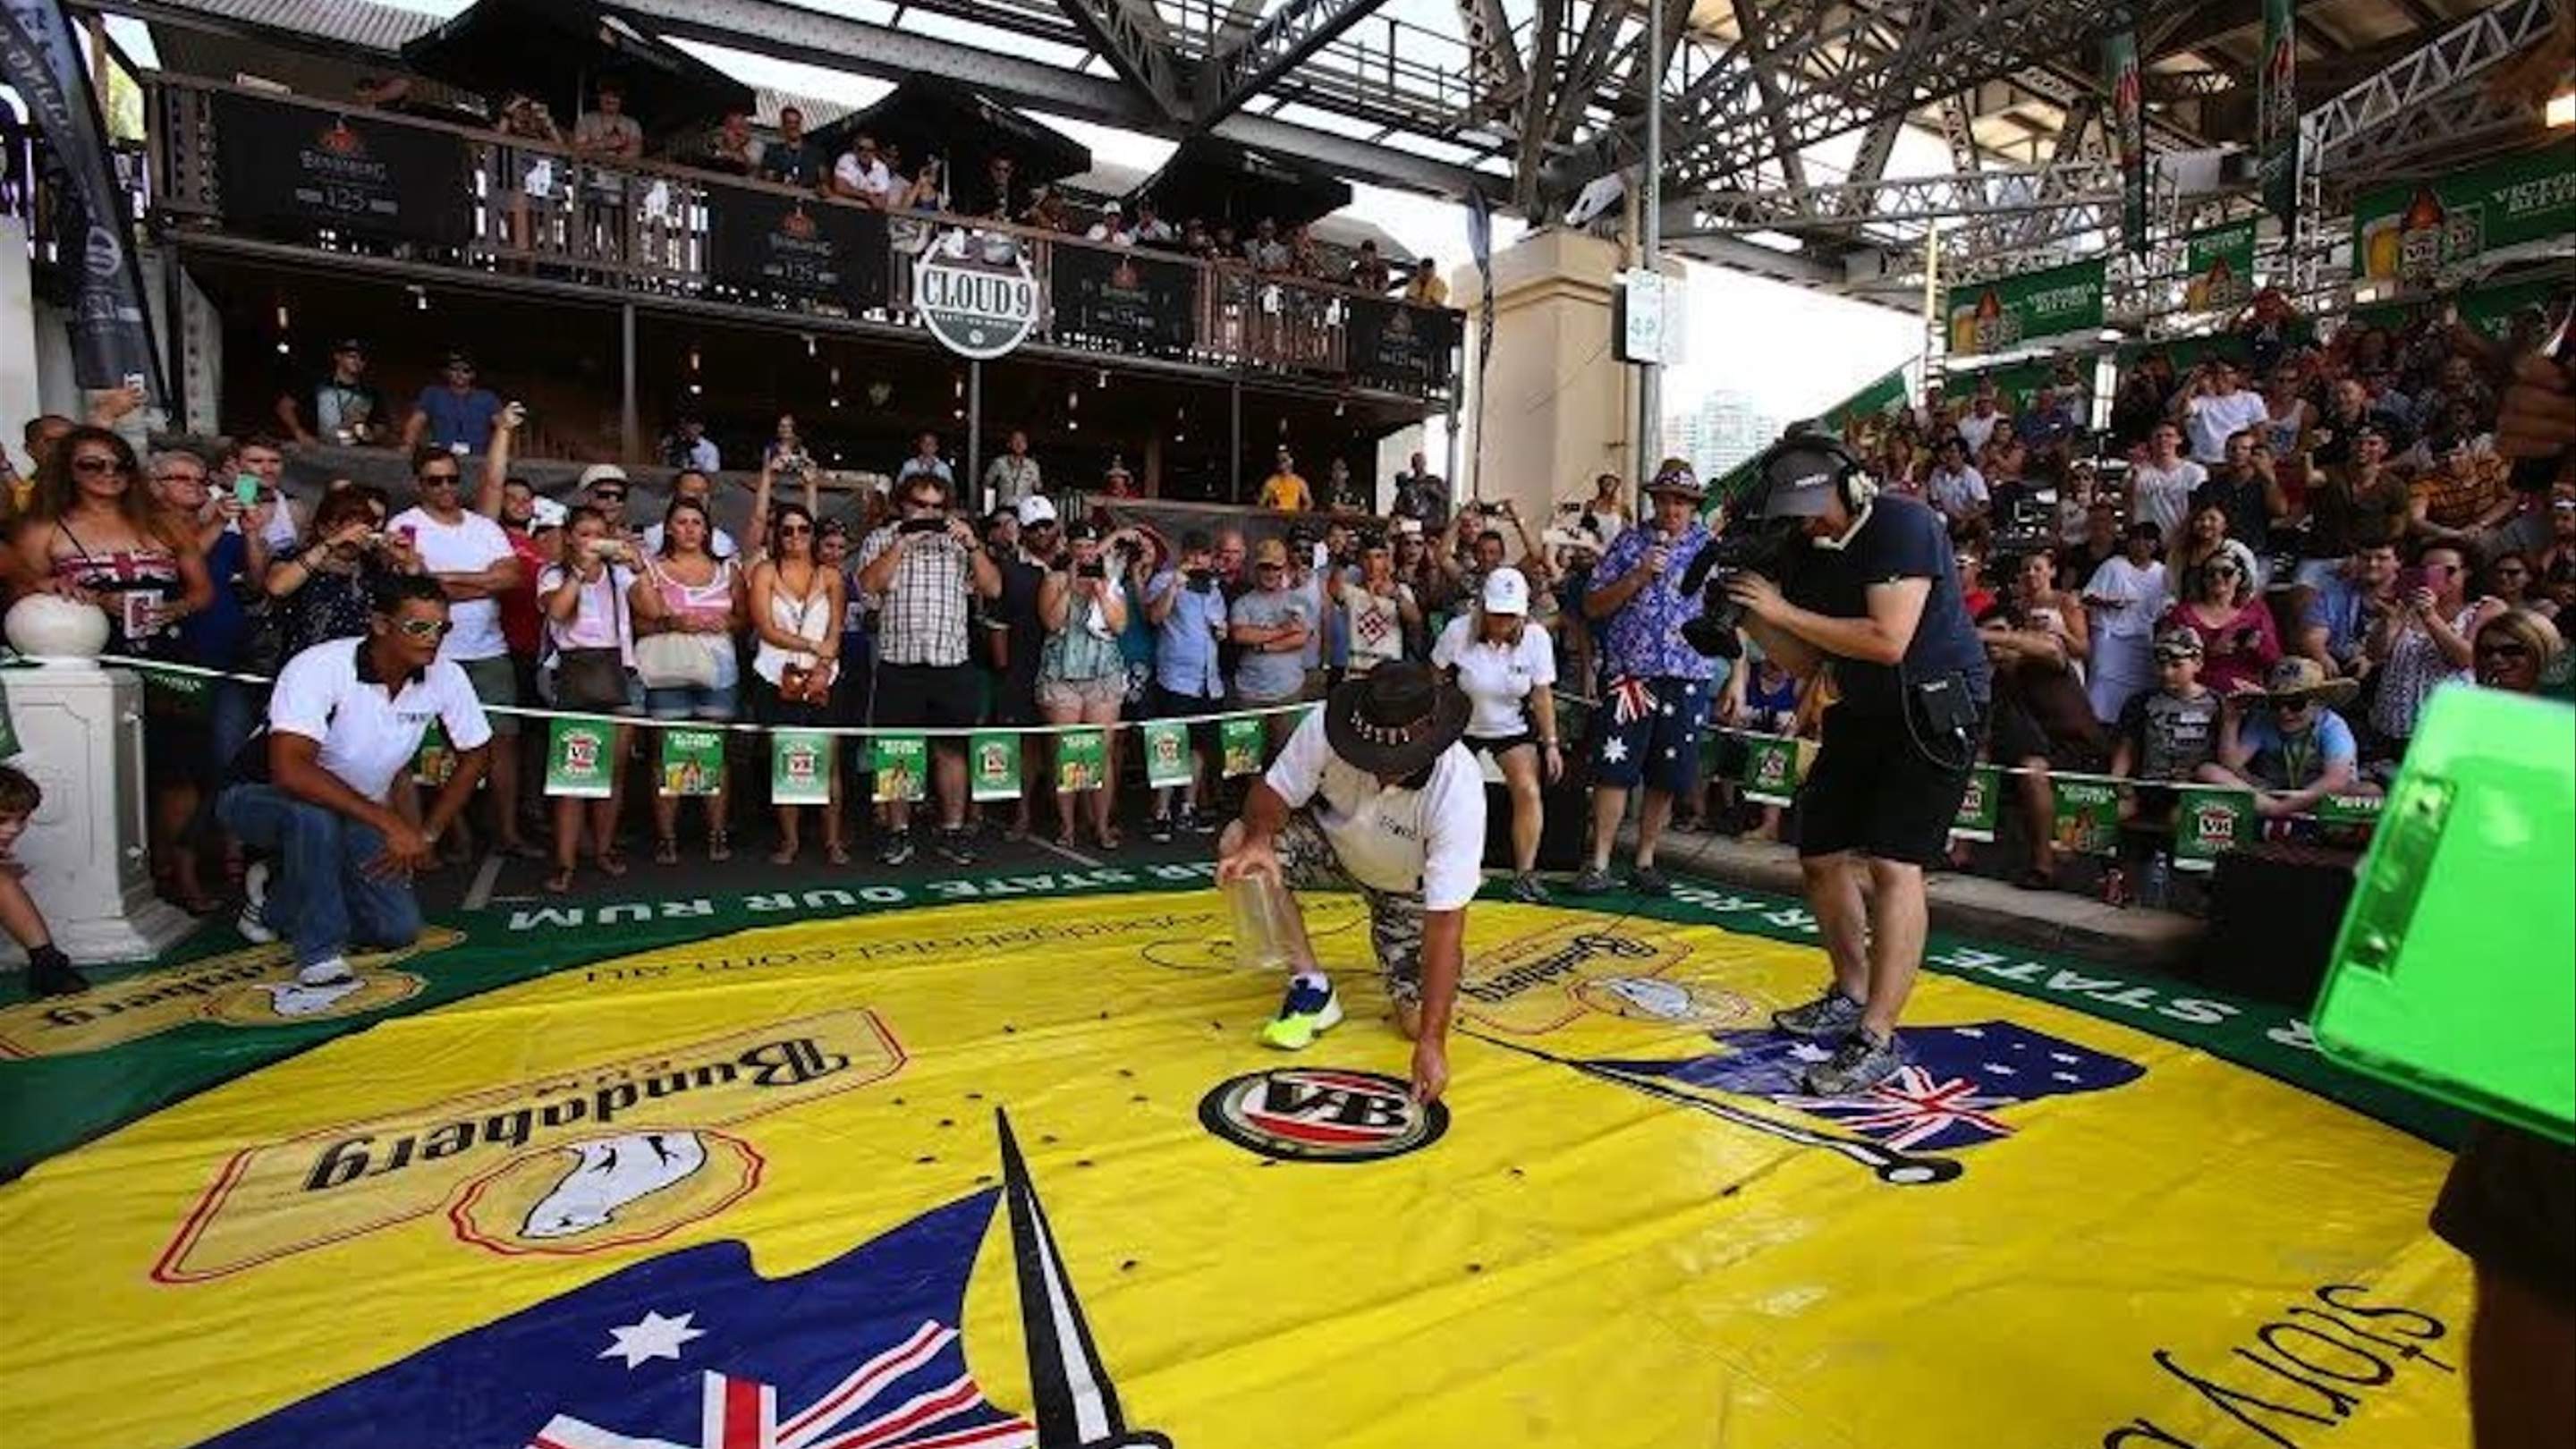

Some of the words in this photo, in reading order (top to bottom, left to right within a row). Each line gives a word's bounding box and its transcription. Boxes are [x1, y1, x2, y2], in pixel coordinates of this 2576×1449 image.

[922, 270, 1012, 315] CLOUD
[1016, 282, 1032, 318] 9
[746, 885, 907, 912] OUR
[924, 866, 1137, 897] STATE
[507, 896, 716, 931] RUM
[1927, 945, 2243, 1026] STATE
[302, 1038, 851, 1192] Bundaberg
[1264, 1080, 1408, 1127] VB
[2152, 1284, 2456, 1449] Story
